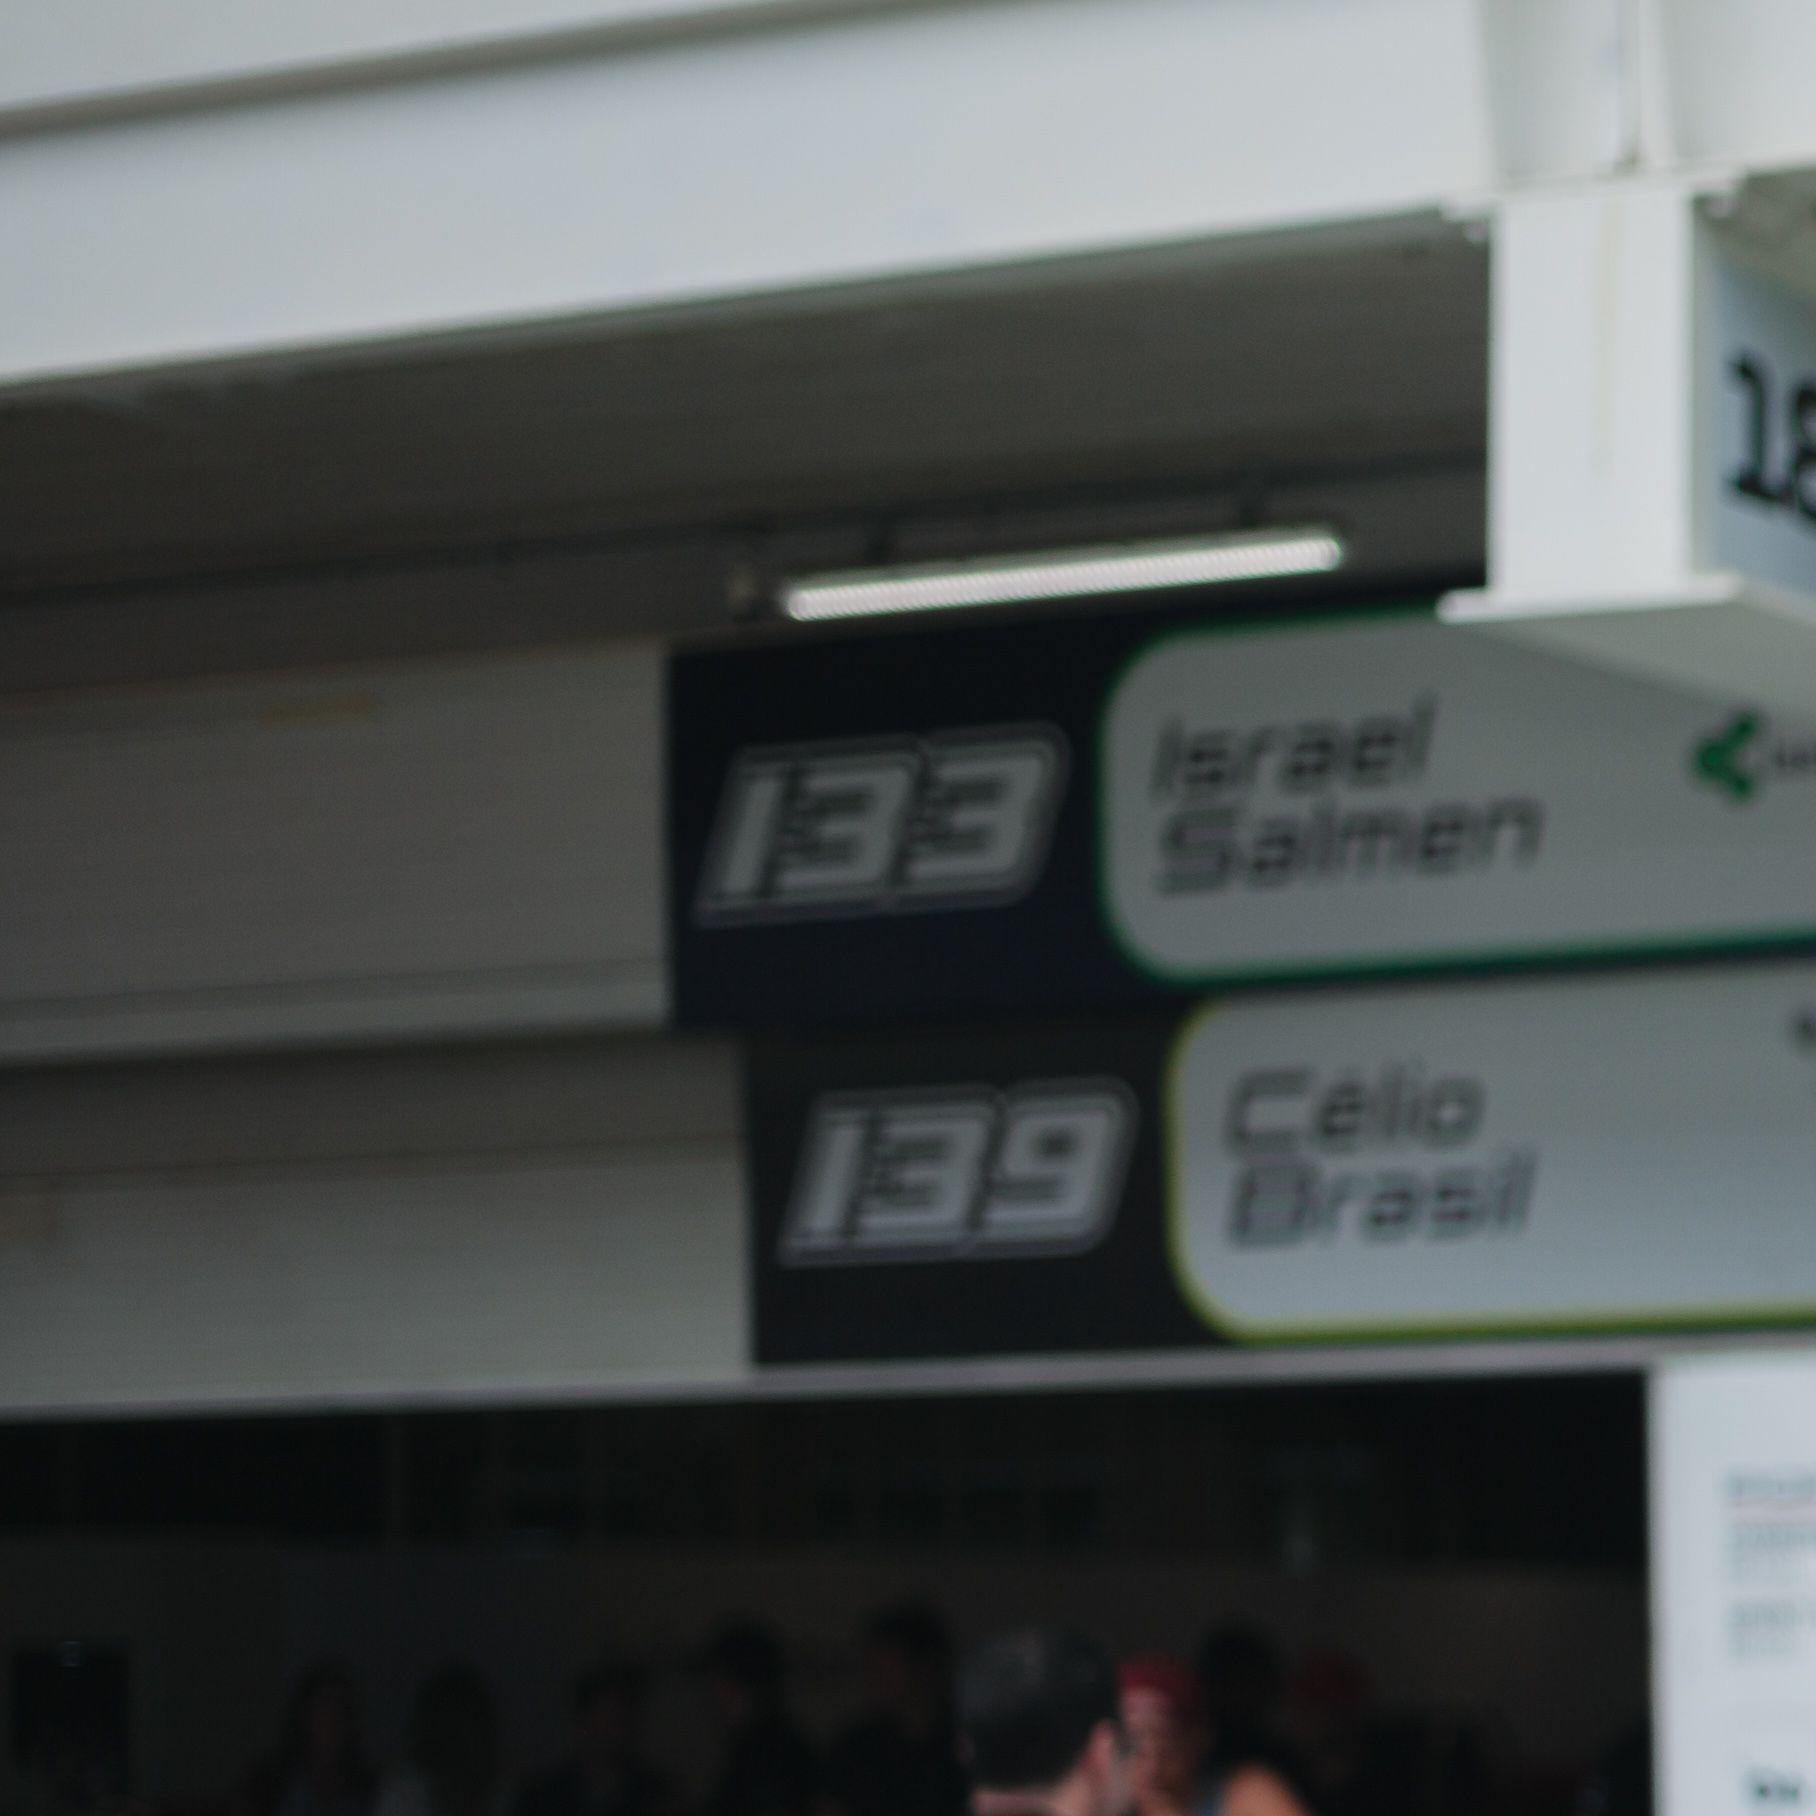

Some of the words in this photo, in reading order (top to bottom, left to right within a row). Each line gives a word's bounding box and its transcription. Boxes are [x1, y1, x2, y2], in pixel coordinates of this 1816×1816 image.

[1150, 690, 1440, 800] Israel
[698, 722, 1068, 924] 133
[1155, 797, 1546, 898] Salmen
[785, 1078, 1139, 1264] 139
